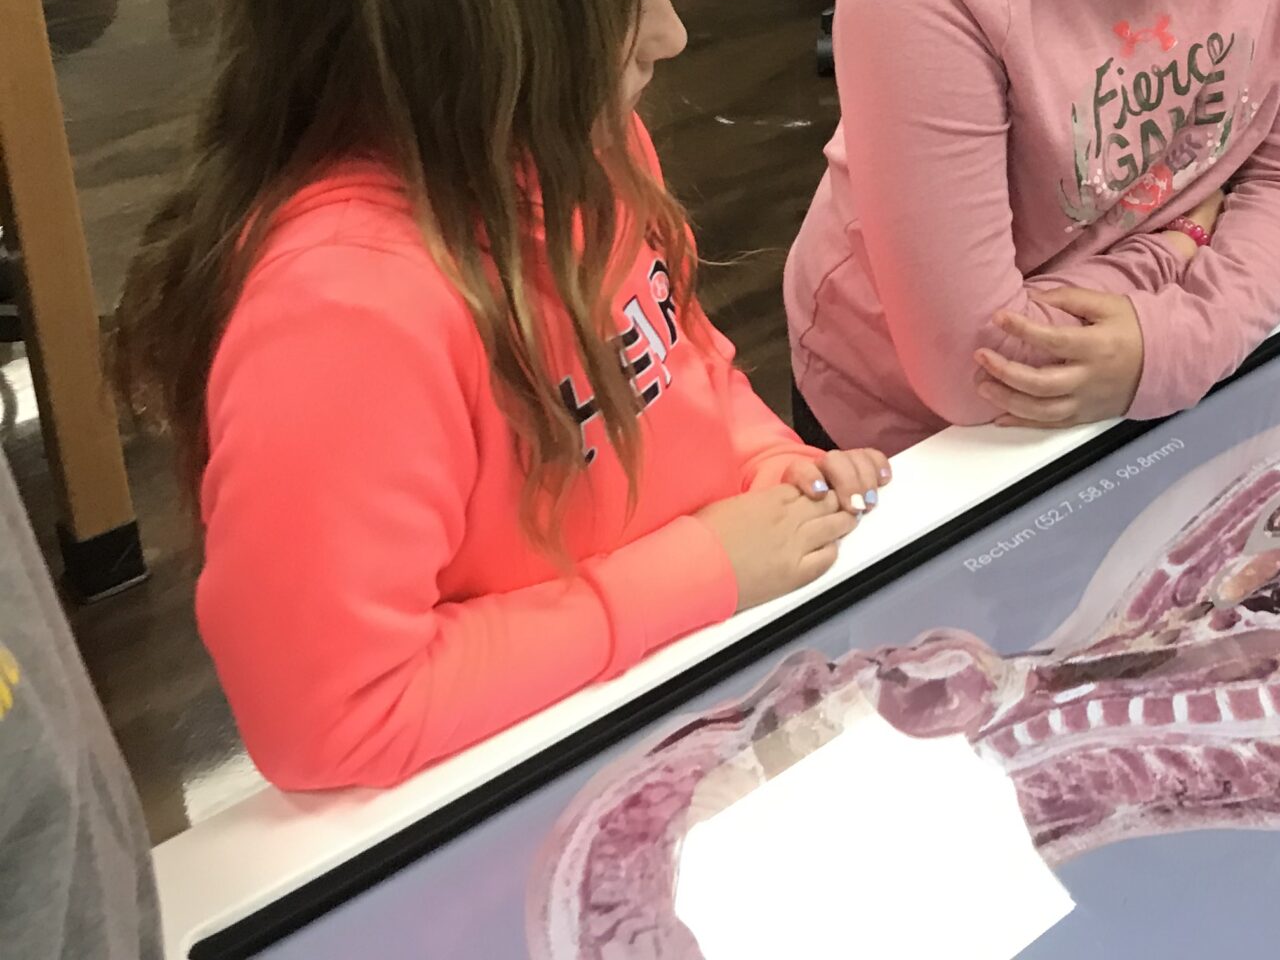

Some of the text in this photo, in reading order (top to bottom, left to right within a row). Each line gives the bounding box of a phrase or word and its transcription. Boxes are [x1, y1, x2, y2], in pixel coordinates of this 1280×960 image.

[1093, 32, 1235, 159] Fierce
[963, 526, 1037, 573] Rectum
[1115, 437, 1186, 479] 96.8mm)
